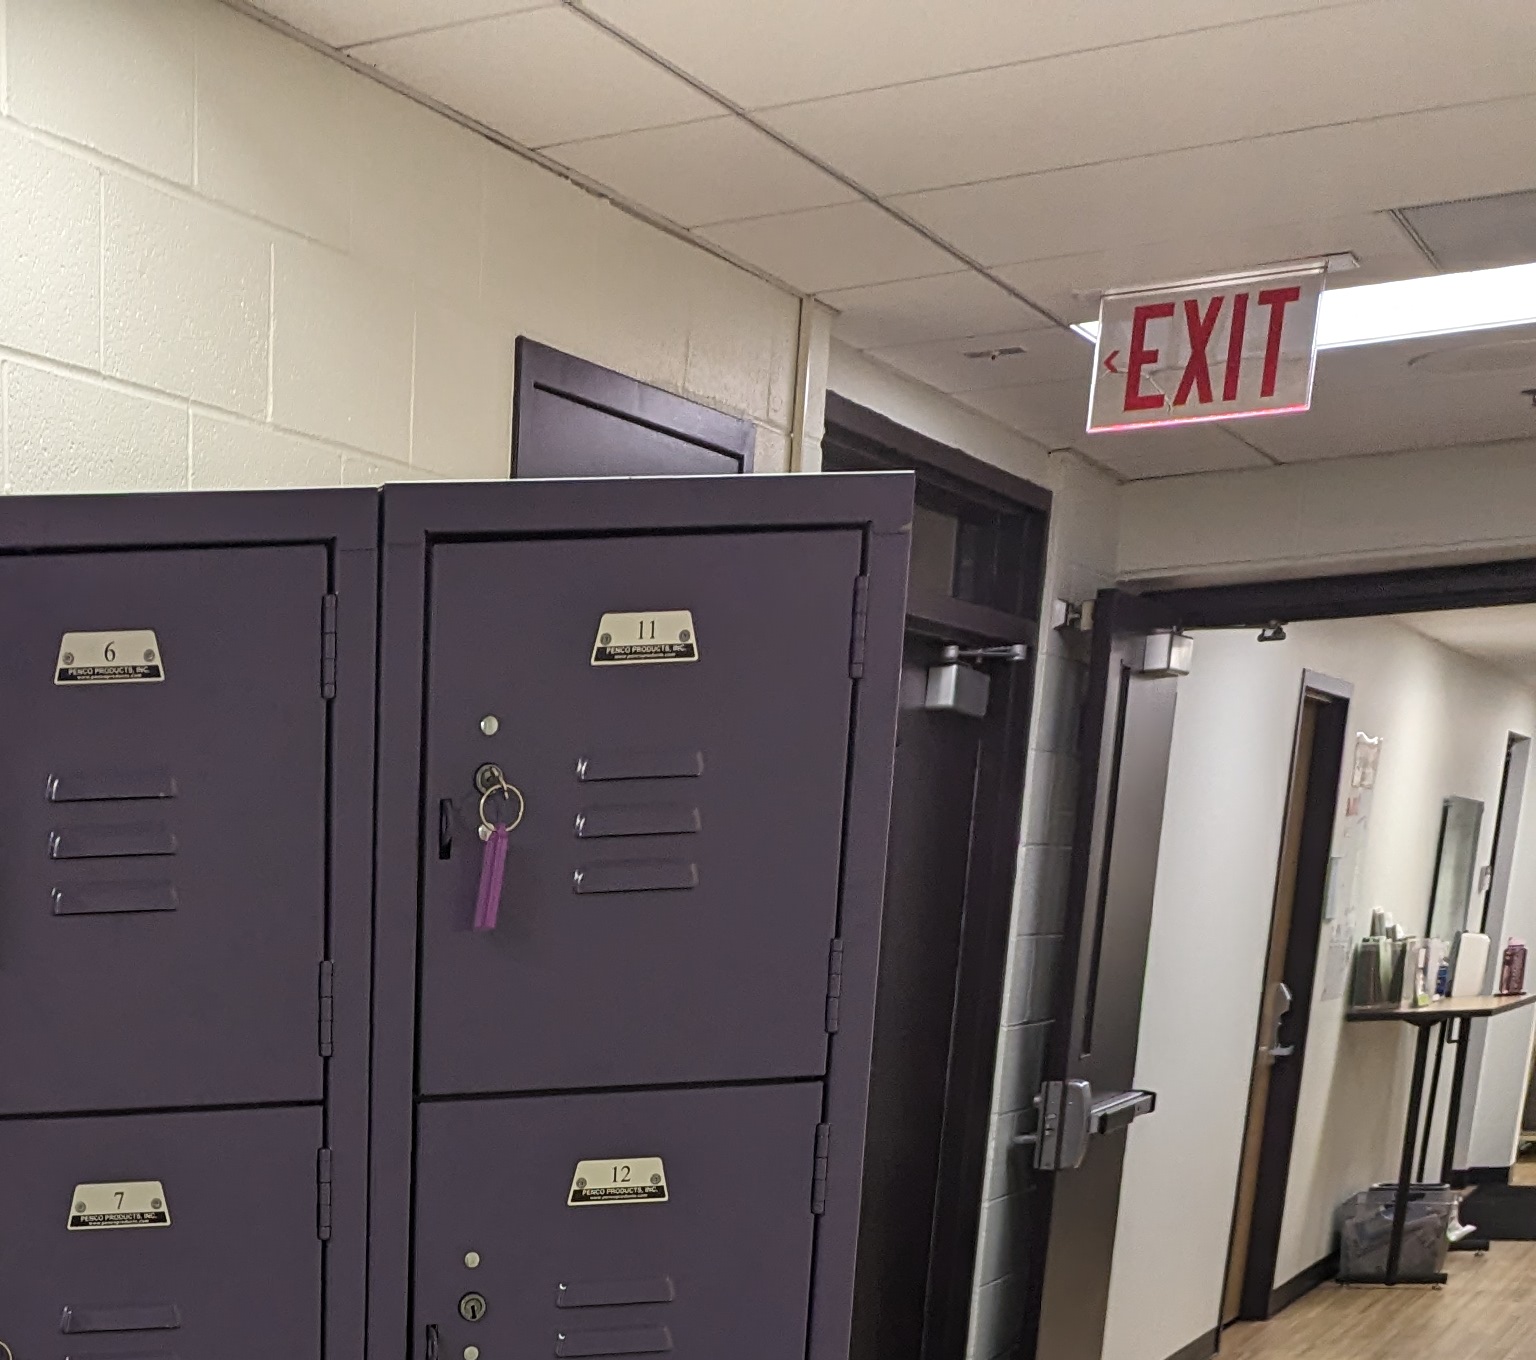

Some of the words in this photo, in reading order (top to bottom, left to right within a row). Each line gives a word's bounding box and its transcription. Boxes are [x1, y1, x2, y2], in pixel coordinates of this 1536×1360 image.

[1124, 286, 1301, 411] EXIT
[638, 620, 655, 640] 11
[104, 640, 116, 662] 6
[606, 646, 631, 654] PENCO
[632, 645, 672, 653] PRODUCTS,
[672, 644, 687, 652] INC.
[94, 666, 134, 674] PRODUCTS,
[612, 1165, 631, 1183] 12
[606, 1187, 644, 1195] PRODUCTS,
[114, 1192, 124, 1210] 7
[104, 1213, 142, 1221] PRODUCTS,
